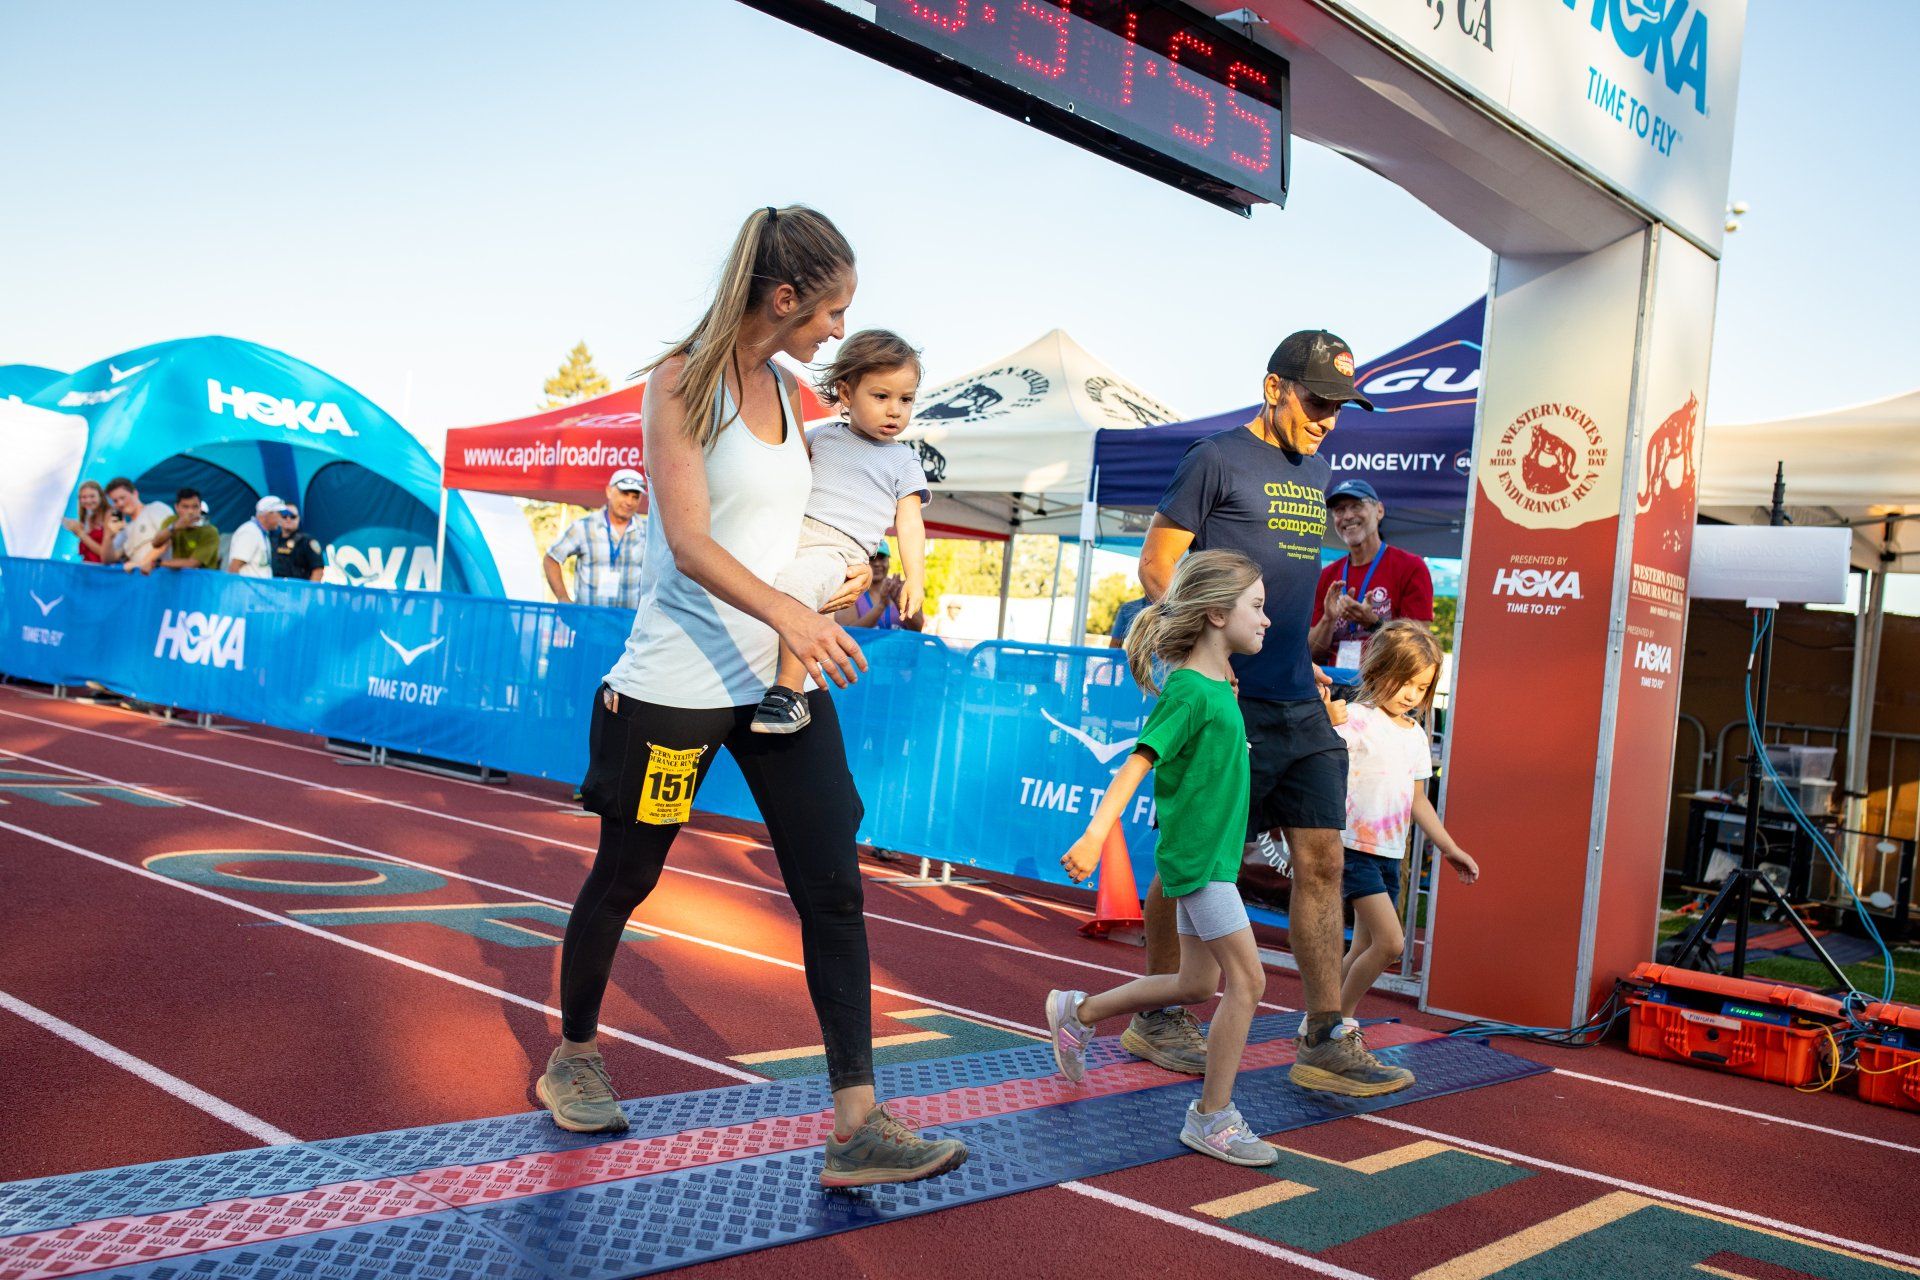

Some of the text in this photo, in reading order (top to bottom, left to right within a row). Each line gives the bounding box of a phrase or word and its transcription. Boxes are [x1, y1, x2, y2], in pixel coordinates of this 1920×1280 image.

[1562, 0, 1708, 116] OKA
[1586, 66, 1677, 158] TIME TO FLY
[1362, 367, 1480, 395] GU
[206, 378, 355, 437] HOKA
[1500, 402, 1603, 446] WESTERN STATES
[1330, 453, 1446, 472] LONGEVITY
[1489, 458, 1517, 467] MILES
[1496, 448, 1513, 457] 100
[1587, 448, 1608, 457] ONE
[1587, 458, 1607, 467] DAY
[1498, 470, 1599, 514] ENDURANCE RUN
[1268, 500, 1328, 525] running
[1267, 517, 1328, 540] company
[1510, 554, 1568, 566] PRESENTED BY
[1633, 563, 1667, 586] WESTERN
[1492, 567, 1581, 600] HOKA
[1631, 579, 1673, 603] ENDURANCE
[1506, 602, 1562, 616] TIME TO FLY
[154, 608, 247, 672] HOKA
[1634, 640, 1672, 675] HOKA
[367, 675, 443, 707] TIME TO FLY
[649, 771, 696, 802] 151
[1020, 776, 1084, 815] TIME
[1257, 830, 1295, 880] NDURA
